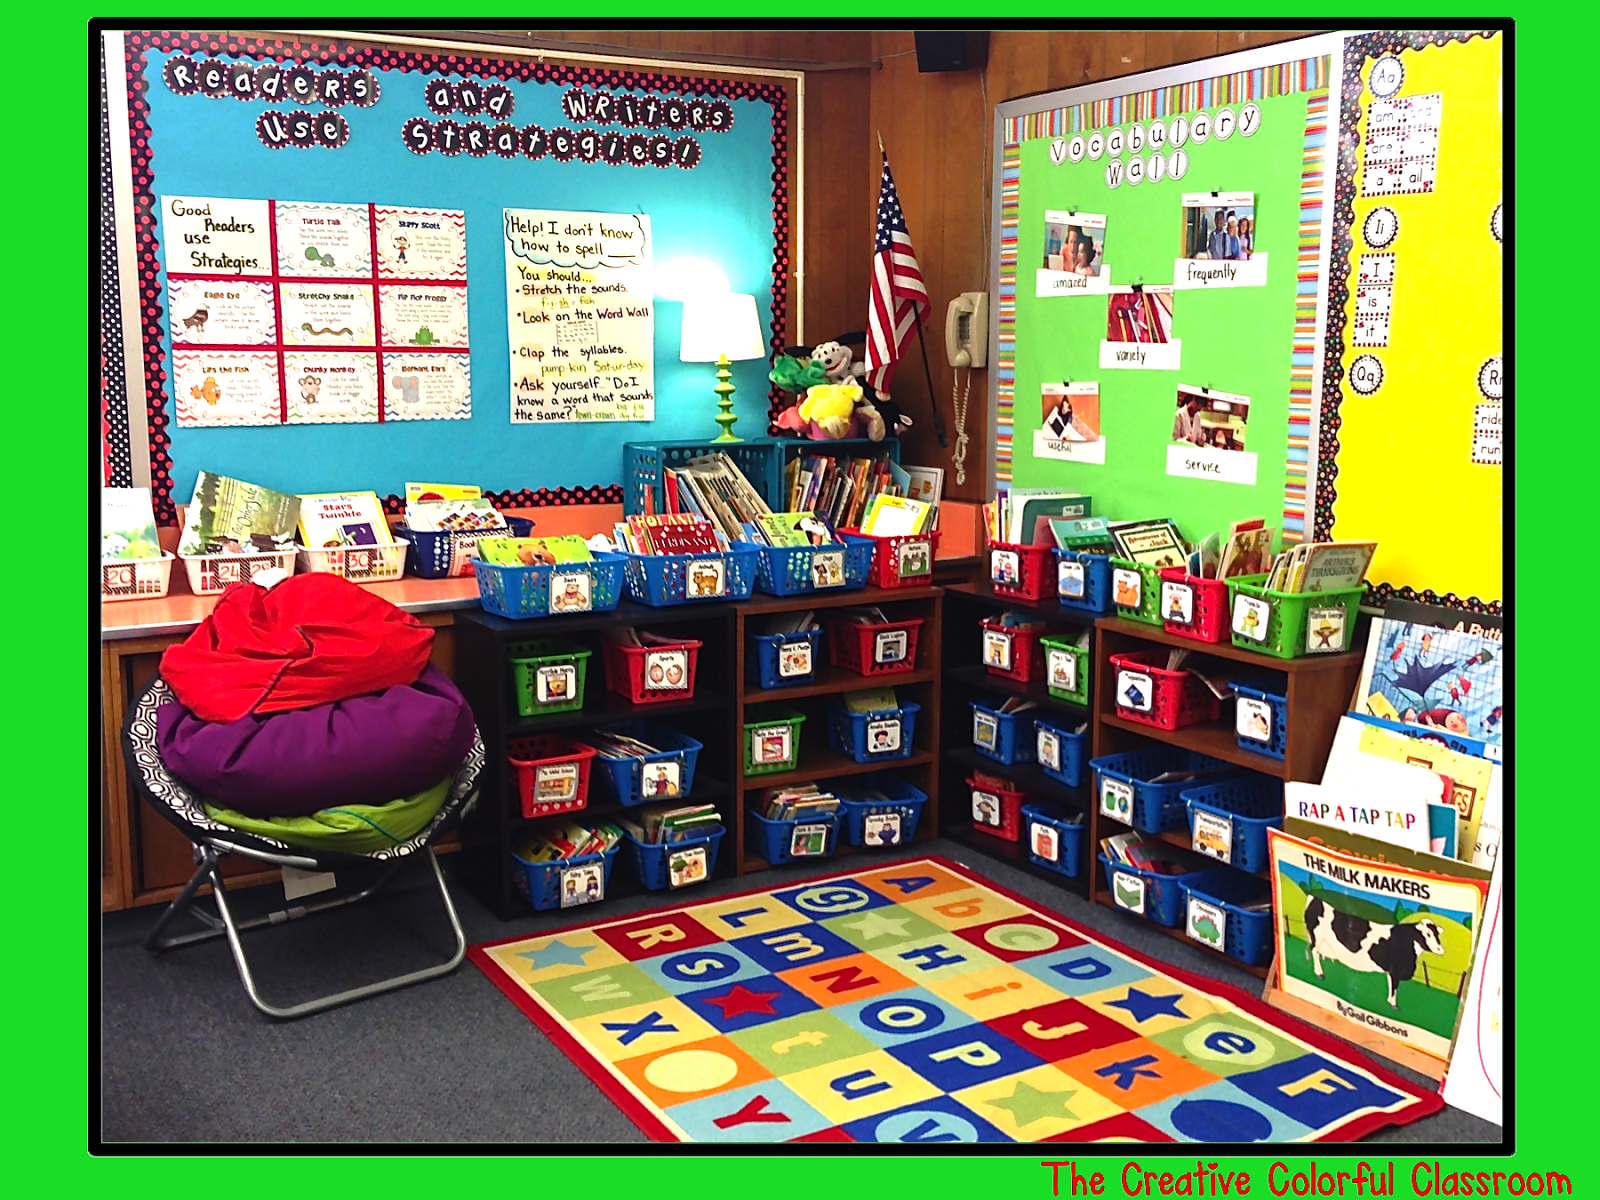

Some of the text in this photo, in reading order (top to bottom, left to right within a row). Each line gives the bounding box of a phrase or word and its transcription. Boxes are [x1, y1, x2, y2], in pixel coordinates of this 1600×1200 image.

[1376, 68, 1395, 83] Aa
[434, 88, 507, 112] and
[1375, 111, 1394, 122] am
[263, 115, 339, 142] Use
[1051, 109, 1255, 161] Vocabulary
[1371, 143, 1392, 154] are
[1108, 152, 1180, 185] Wall
[1376, 167, 1423, 186] a all
[171, 199, 211, 216] Good
[204, 216, 255, 233] Readers
[302, 218, 341, 226] Turtle Talk
[421, 221, 441, 230] Scott
[510, 215, 634, 240] Help! I don't know
[184, 233, 211, 244] use
[521, 238, 603, 259] how to spell
[517, 265, 540, 281] You
[1053, 261, 1237, 289] amazed frequently
[1373, 262, 1380, 277] I
[204, 291, 240, 300] Eagle Eye
[298, 292, 330, 301] Stretchy
[522, 284, 562, 295] Stretch
[566, 283, 587, 295] the
[1368, 296, 1377, 308] is
[523, 310, 550, 324] Look
[555, 313, 570, 322] on
[574, 308, 593, 320] the
[596, 307, 624, 319] Word
[1366, 324, 1375, 337] it
[519, 344, 627, 362] Clap the syllables.
[1116, 346, 1146, 365] variety
[219, 366, 232, 374] the
[234, 366, 250, 374] Fish
[303, 366, 356, 374] Chunky Monkey
[401, 365, 446, 373] Elephant Ears
[1357, 366, 1375, 386] Qq
[519, 377, 545, 391] Ask
[628, 376, 640, 387] I
[517, 389, 653, 407] know a word that sounds
[514, 408, 533, 421] the
[1048, 440, 1072, 453] useful
[1480, 445, 1501, 455] run
[1185, 459, 1221, 474] service
[317, 511, 362, 519] Twinkle
[322, 503, 353, 512] Stars
[1127, 531, 1168, 545] Adventures of
[348, 552, 369, 569] 30
[106, 568, 133, 586] 20
[218, 564, 240, 581] 24
[1453, 620, 1466, 634] A
[658, 655, 675, 663] Sports
[1299, 801, 1416, 830] RAP A TAP TAP
[882, 875, 937, 893] A
[1303, 852, 1431, 900] THE MILK MAKERS
[940, 898, 984, 919] b
[719, 907, 769, 928] L
[626, 922, 686, 949] R
[898, 944, 967, 971] H
[1048, 956, 1113, 981] D
[809, 965, 880, 994] N
[1336, 1001, 1409, 1038] By Gail Gibbons
[1021, 1020, 1089, 1040] J
[1203, 1027, 1258, 1057] e
[928, 1041, 1001, 1067] P
[1276, 1067, 1359, 1099] F
